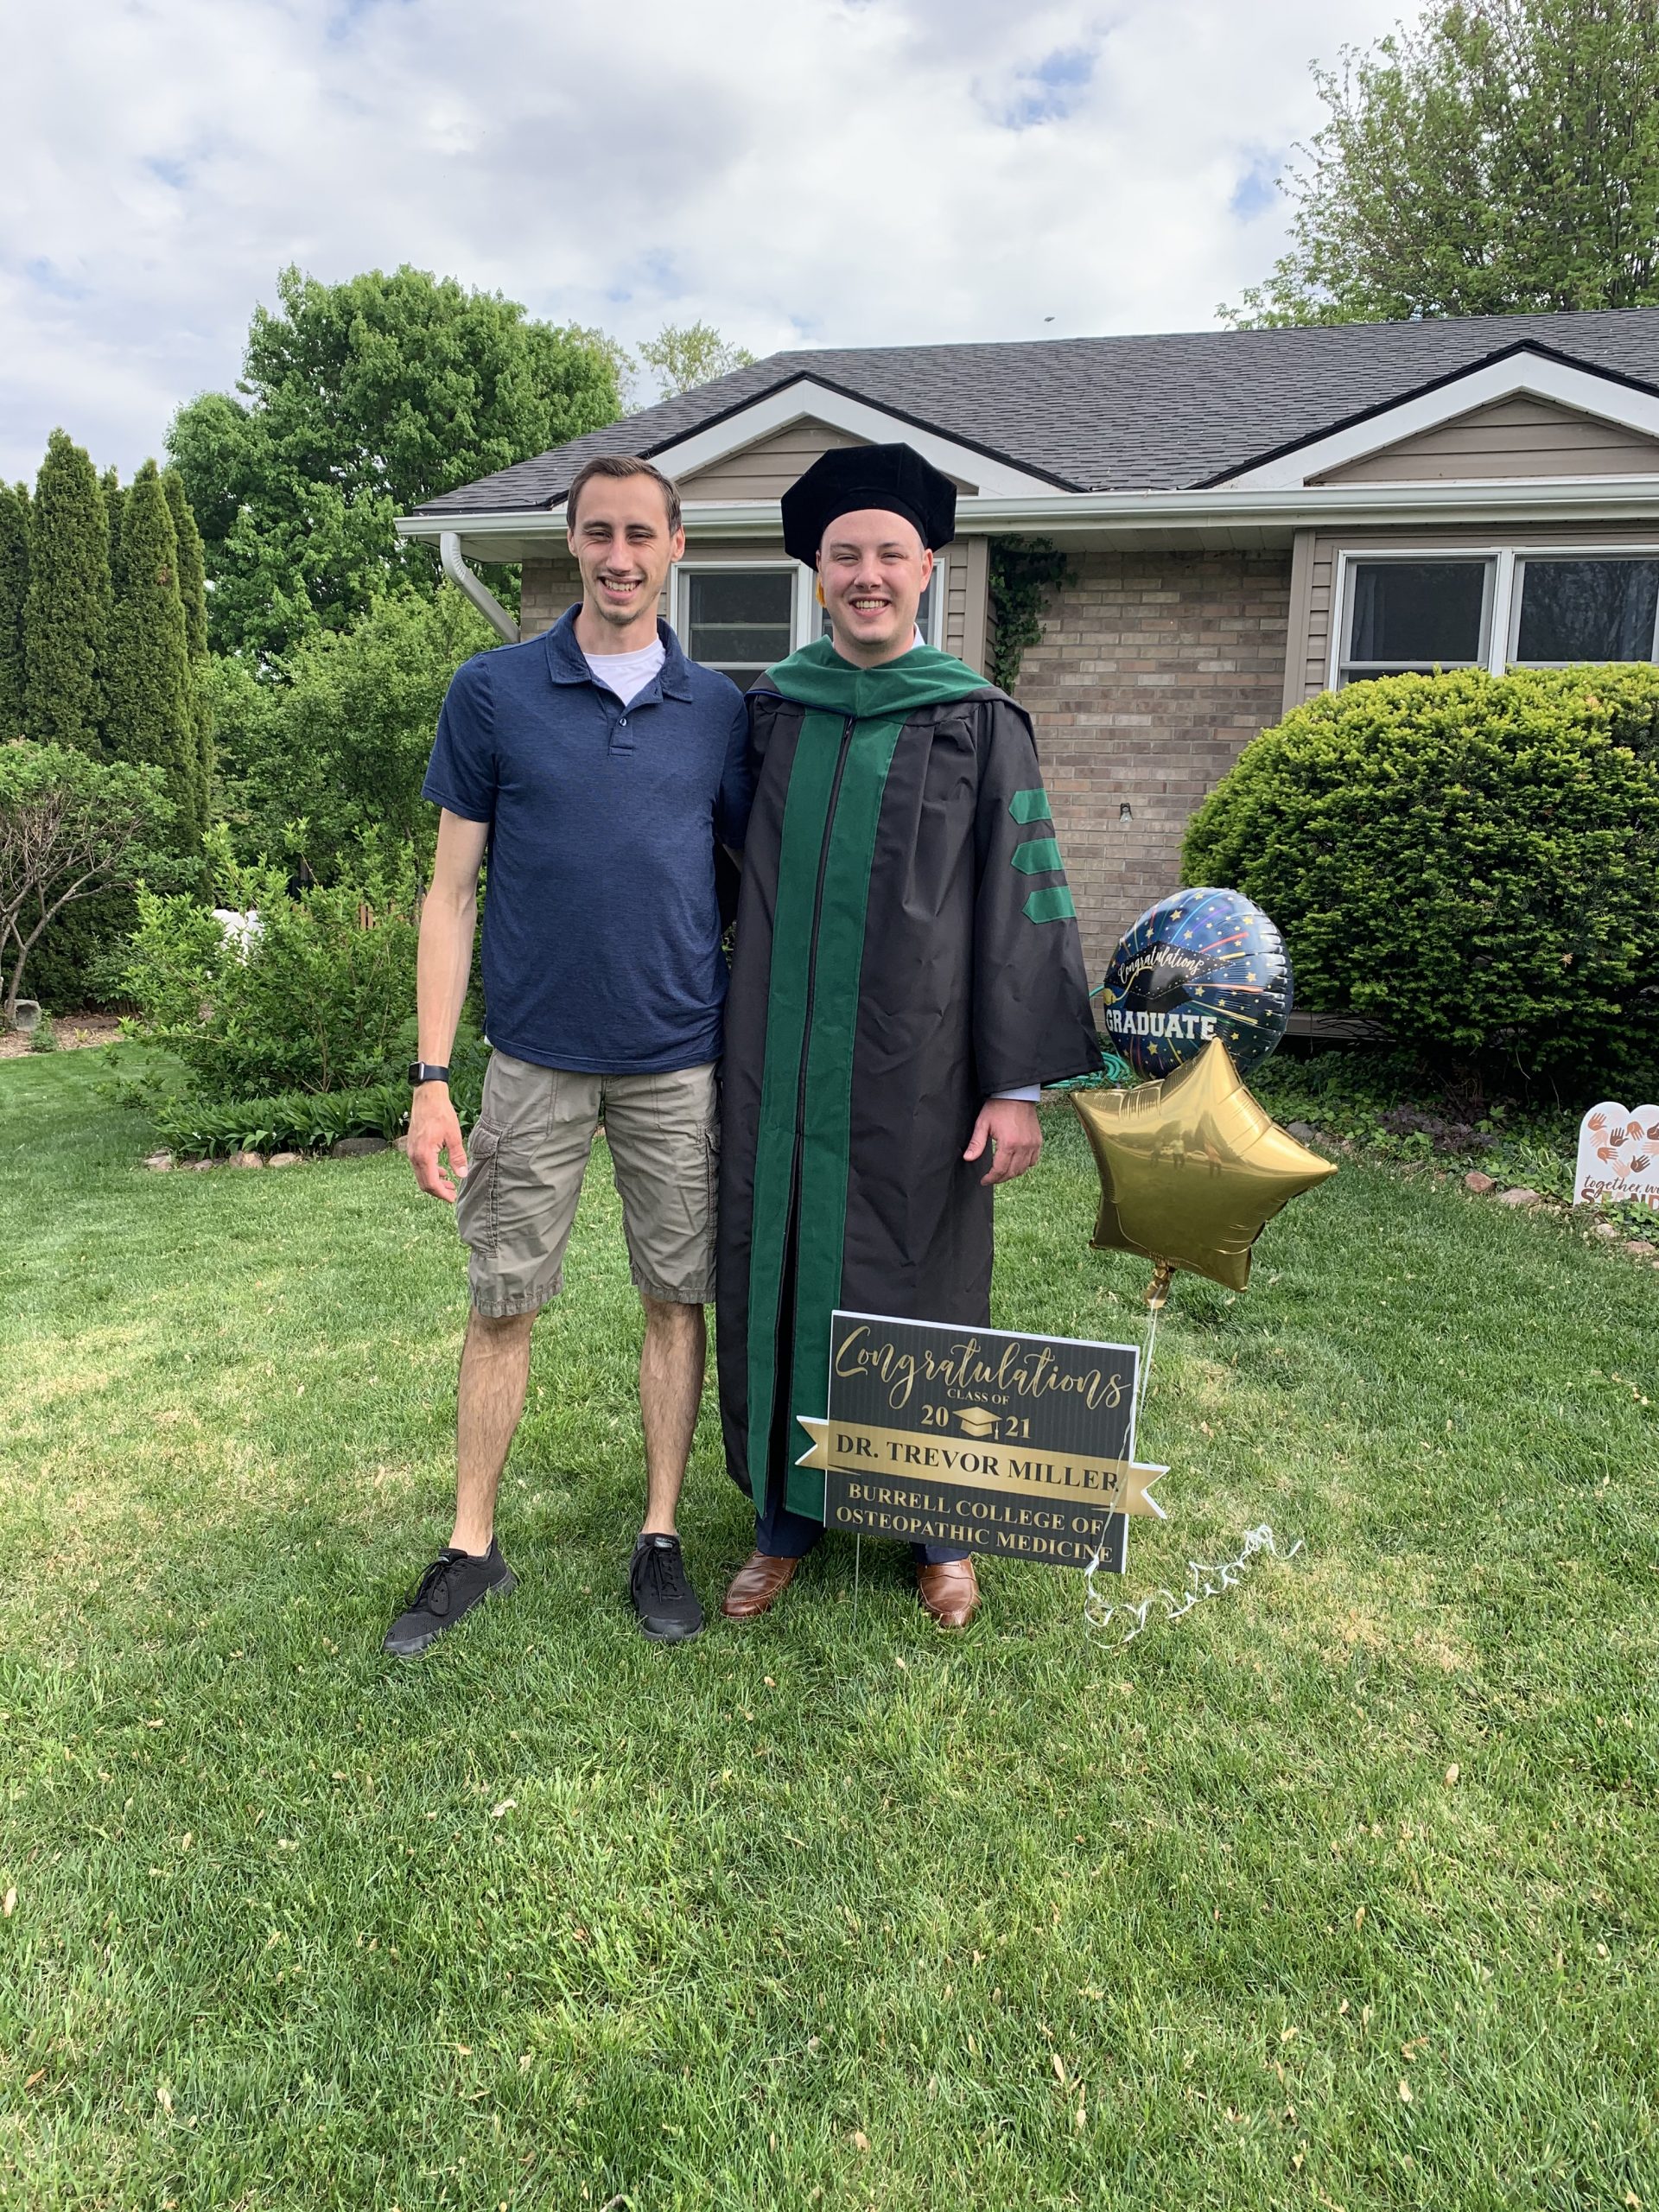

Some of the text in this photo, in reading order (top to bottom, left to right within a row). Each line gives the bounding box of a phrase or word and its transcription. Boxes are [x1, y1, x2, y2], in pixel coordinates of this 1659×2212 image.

[1117, 945, 1205, 984] Congratulations
[1106, 1008, 1217, 1040] GRADUATE
[1584, 1174, 1643, 1198] together,
[835, 1325, 1131, 1410] Congratulations
[947, 1388, 1010, 1405] CLASS OF
[920, 1403, 1031, 1439] 20 21
[836, 1433, 1120, 1492] DR. TREVOR MILLER
[849, 1483, 1104, 1535] BURRELL COLLEGE OF
[836, 1506, 1113, 1563] OSTEOPATHIC MEDICINE
